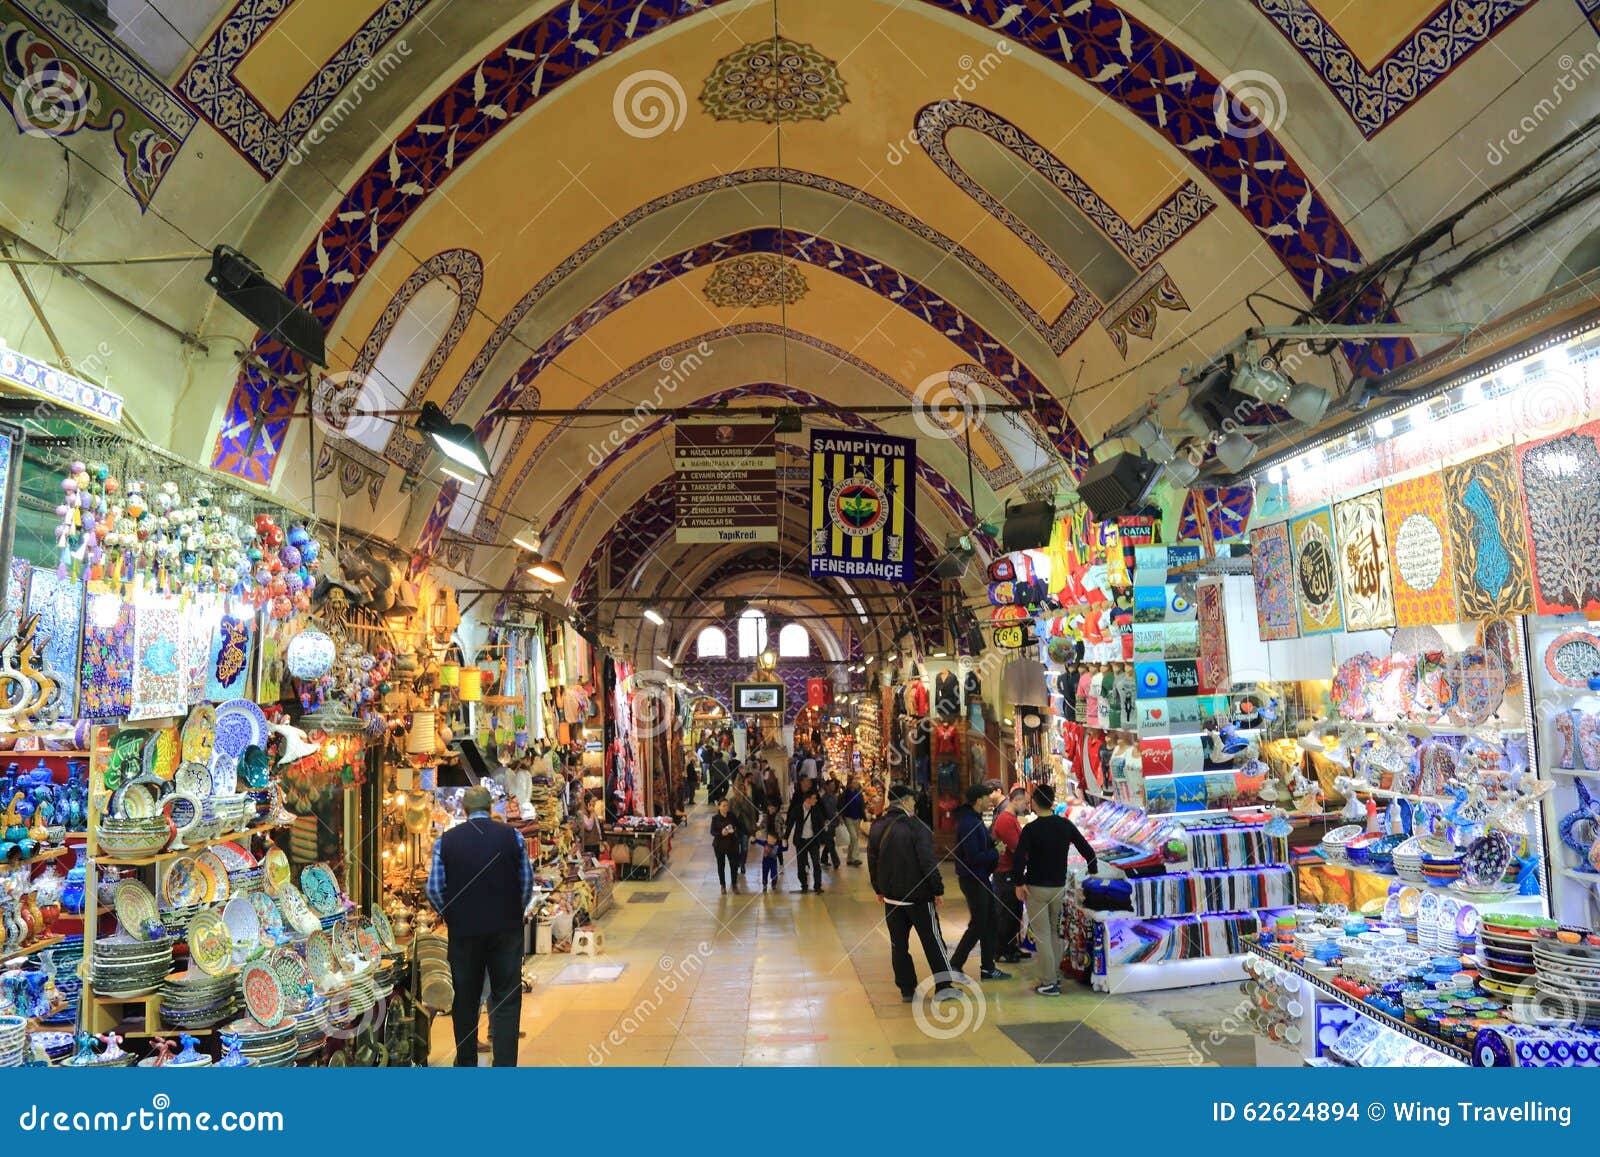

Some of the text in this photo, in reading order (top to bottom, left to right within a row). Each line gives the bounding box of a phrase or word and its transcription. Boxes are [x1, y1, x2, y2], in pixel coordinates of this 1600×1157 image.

[814, 438, 905, 457] ŞAMPİYON
[1123, 527, 1151, 536] QATAR
[811, 558, 904, 580] FENERBAHÇE
